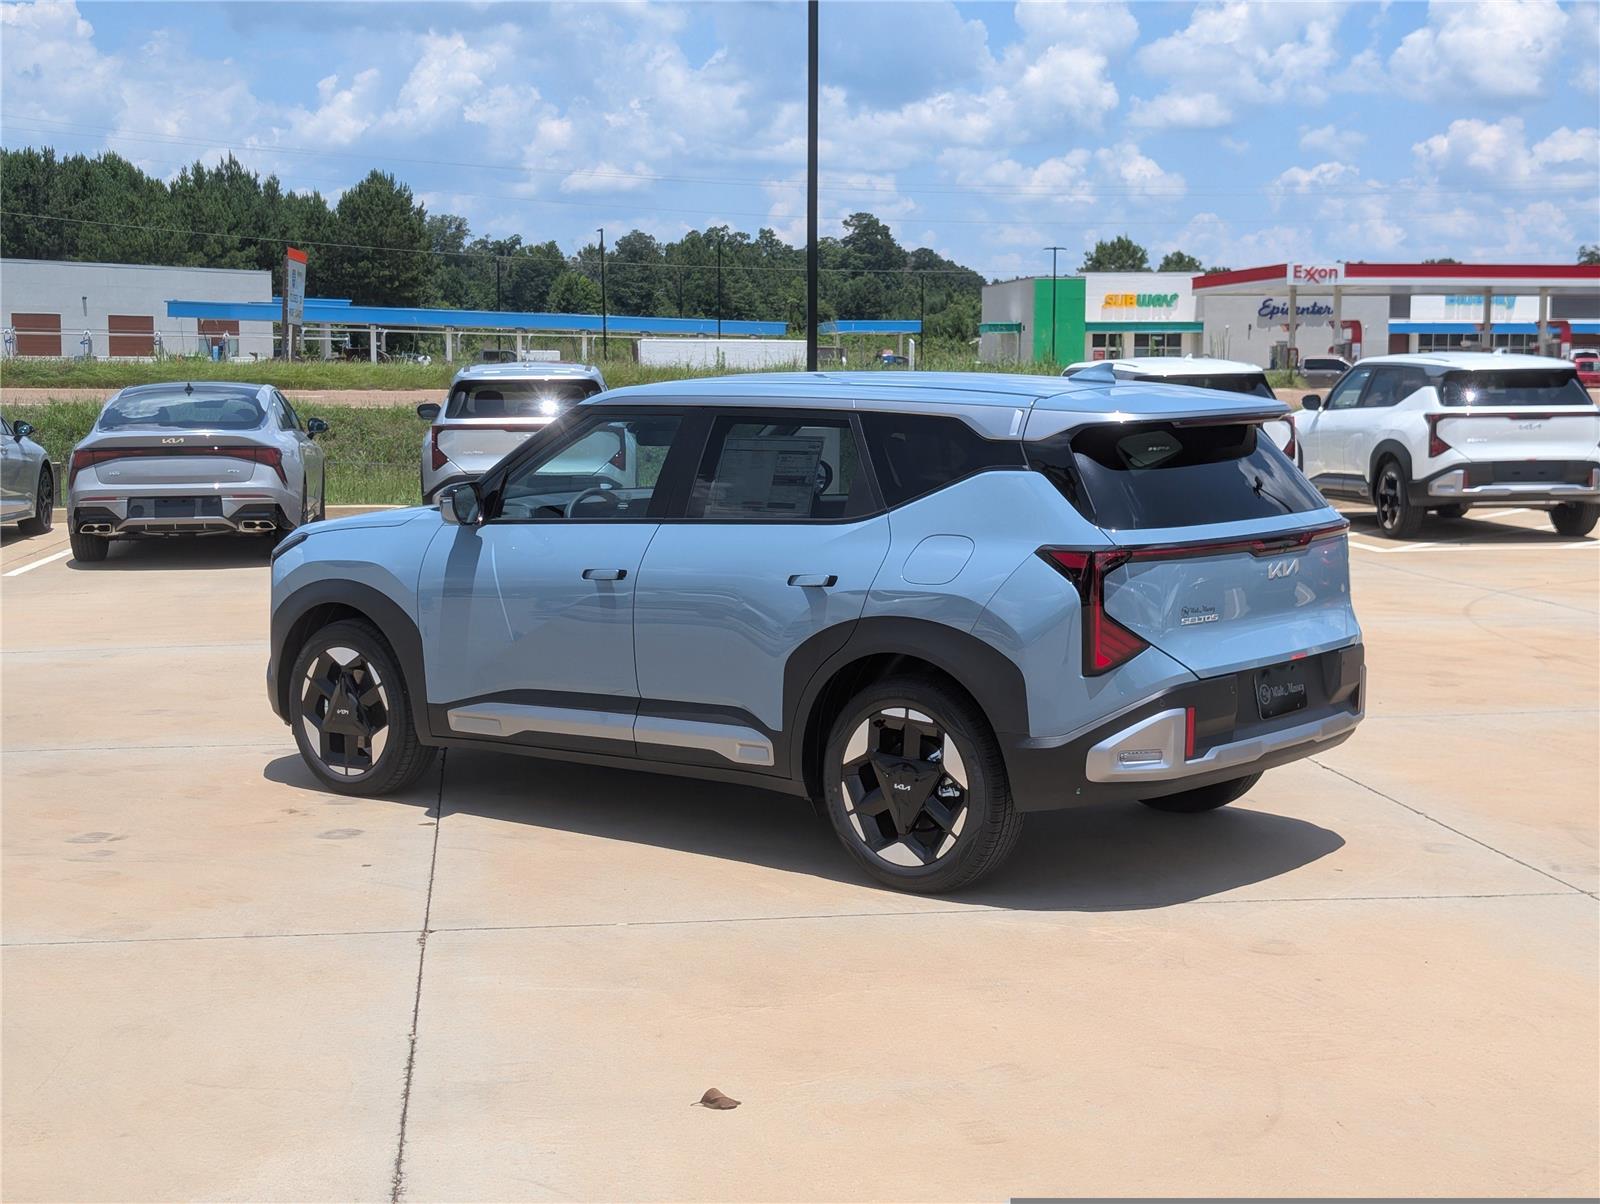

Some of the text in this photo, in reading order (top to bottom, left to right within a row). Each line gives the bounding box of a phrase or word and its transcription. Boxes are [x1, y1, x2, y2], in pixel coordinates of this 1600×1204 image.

[1293, 265, 1338, 284] Exxon
[1104, 292, 1179, 308] SUBWAY
[1267, 558, 1300, 579] KIA
[1181, 613, 1219, 625] SELTOS
[893, 783, 911, 791] KIA
